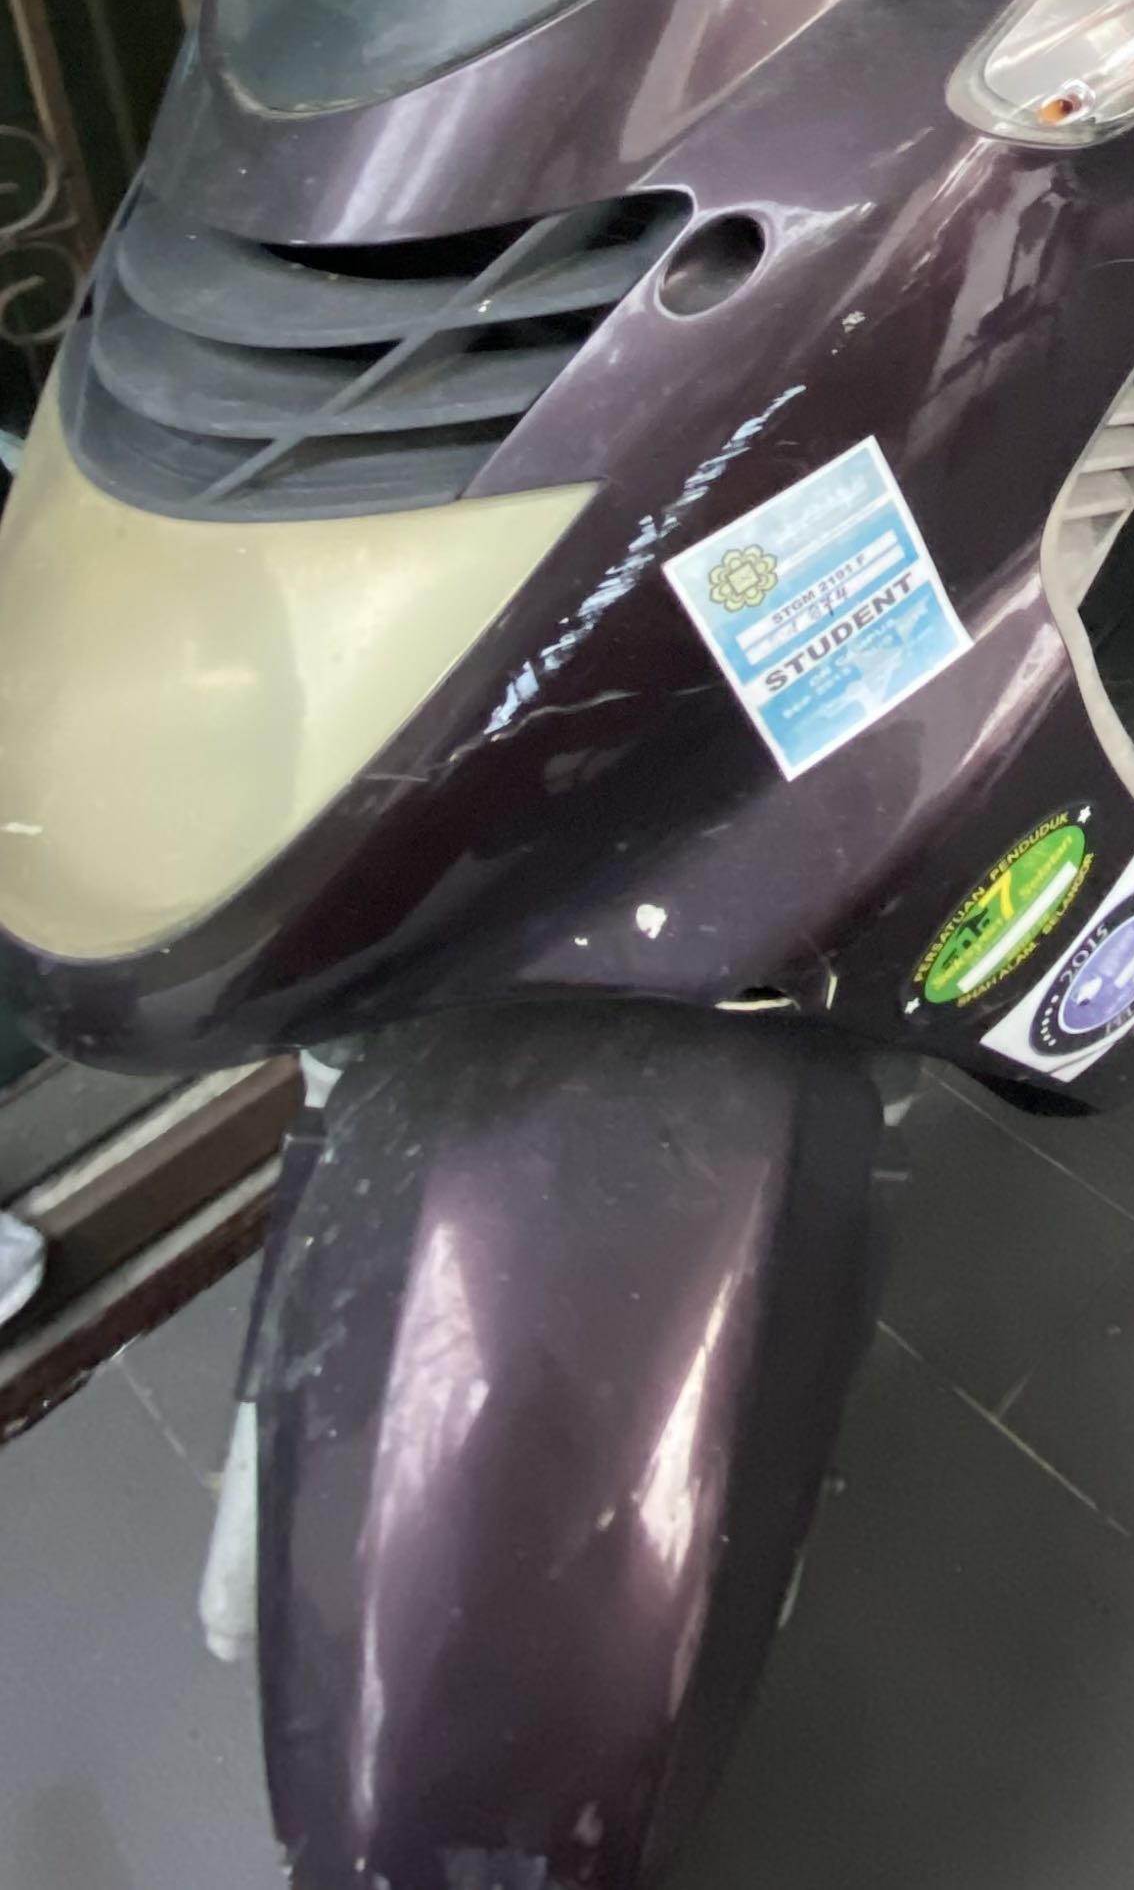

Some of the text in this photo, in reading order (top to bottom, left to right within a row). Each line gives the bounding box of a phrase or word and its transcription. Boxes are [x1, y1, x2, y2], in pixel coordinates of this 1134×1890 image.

[765, 572, 912, 692] STUDENT
[771, 591, 816, 624] STGM
[914, 886, 985, 982] PERSATUAN
[990, 812, 1069, 881] PENDUDUK
[978, 870, 1014, 921] 7
[1000, 942, 1038, 980] ALAM
[1042, 852, 1094, 935] SELANGOR
[1060, 922, 1108, 985] 2015
